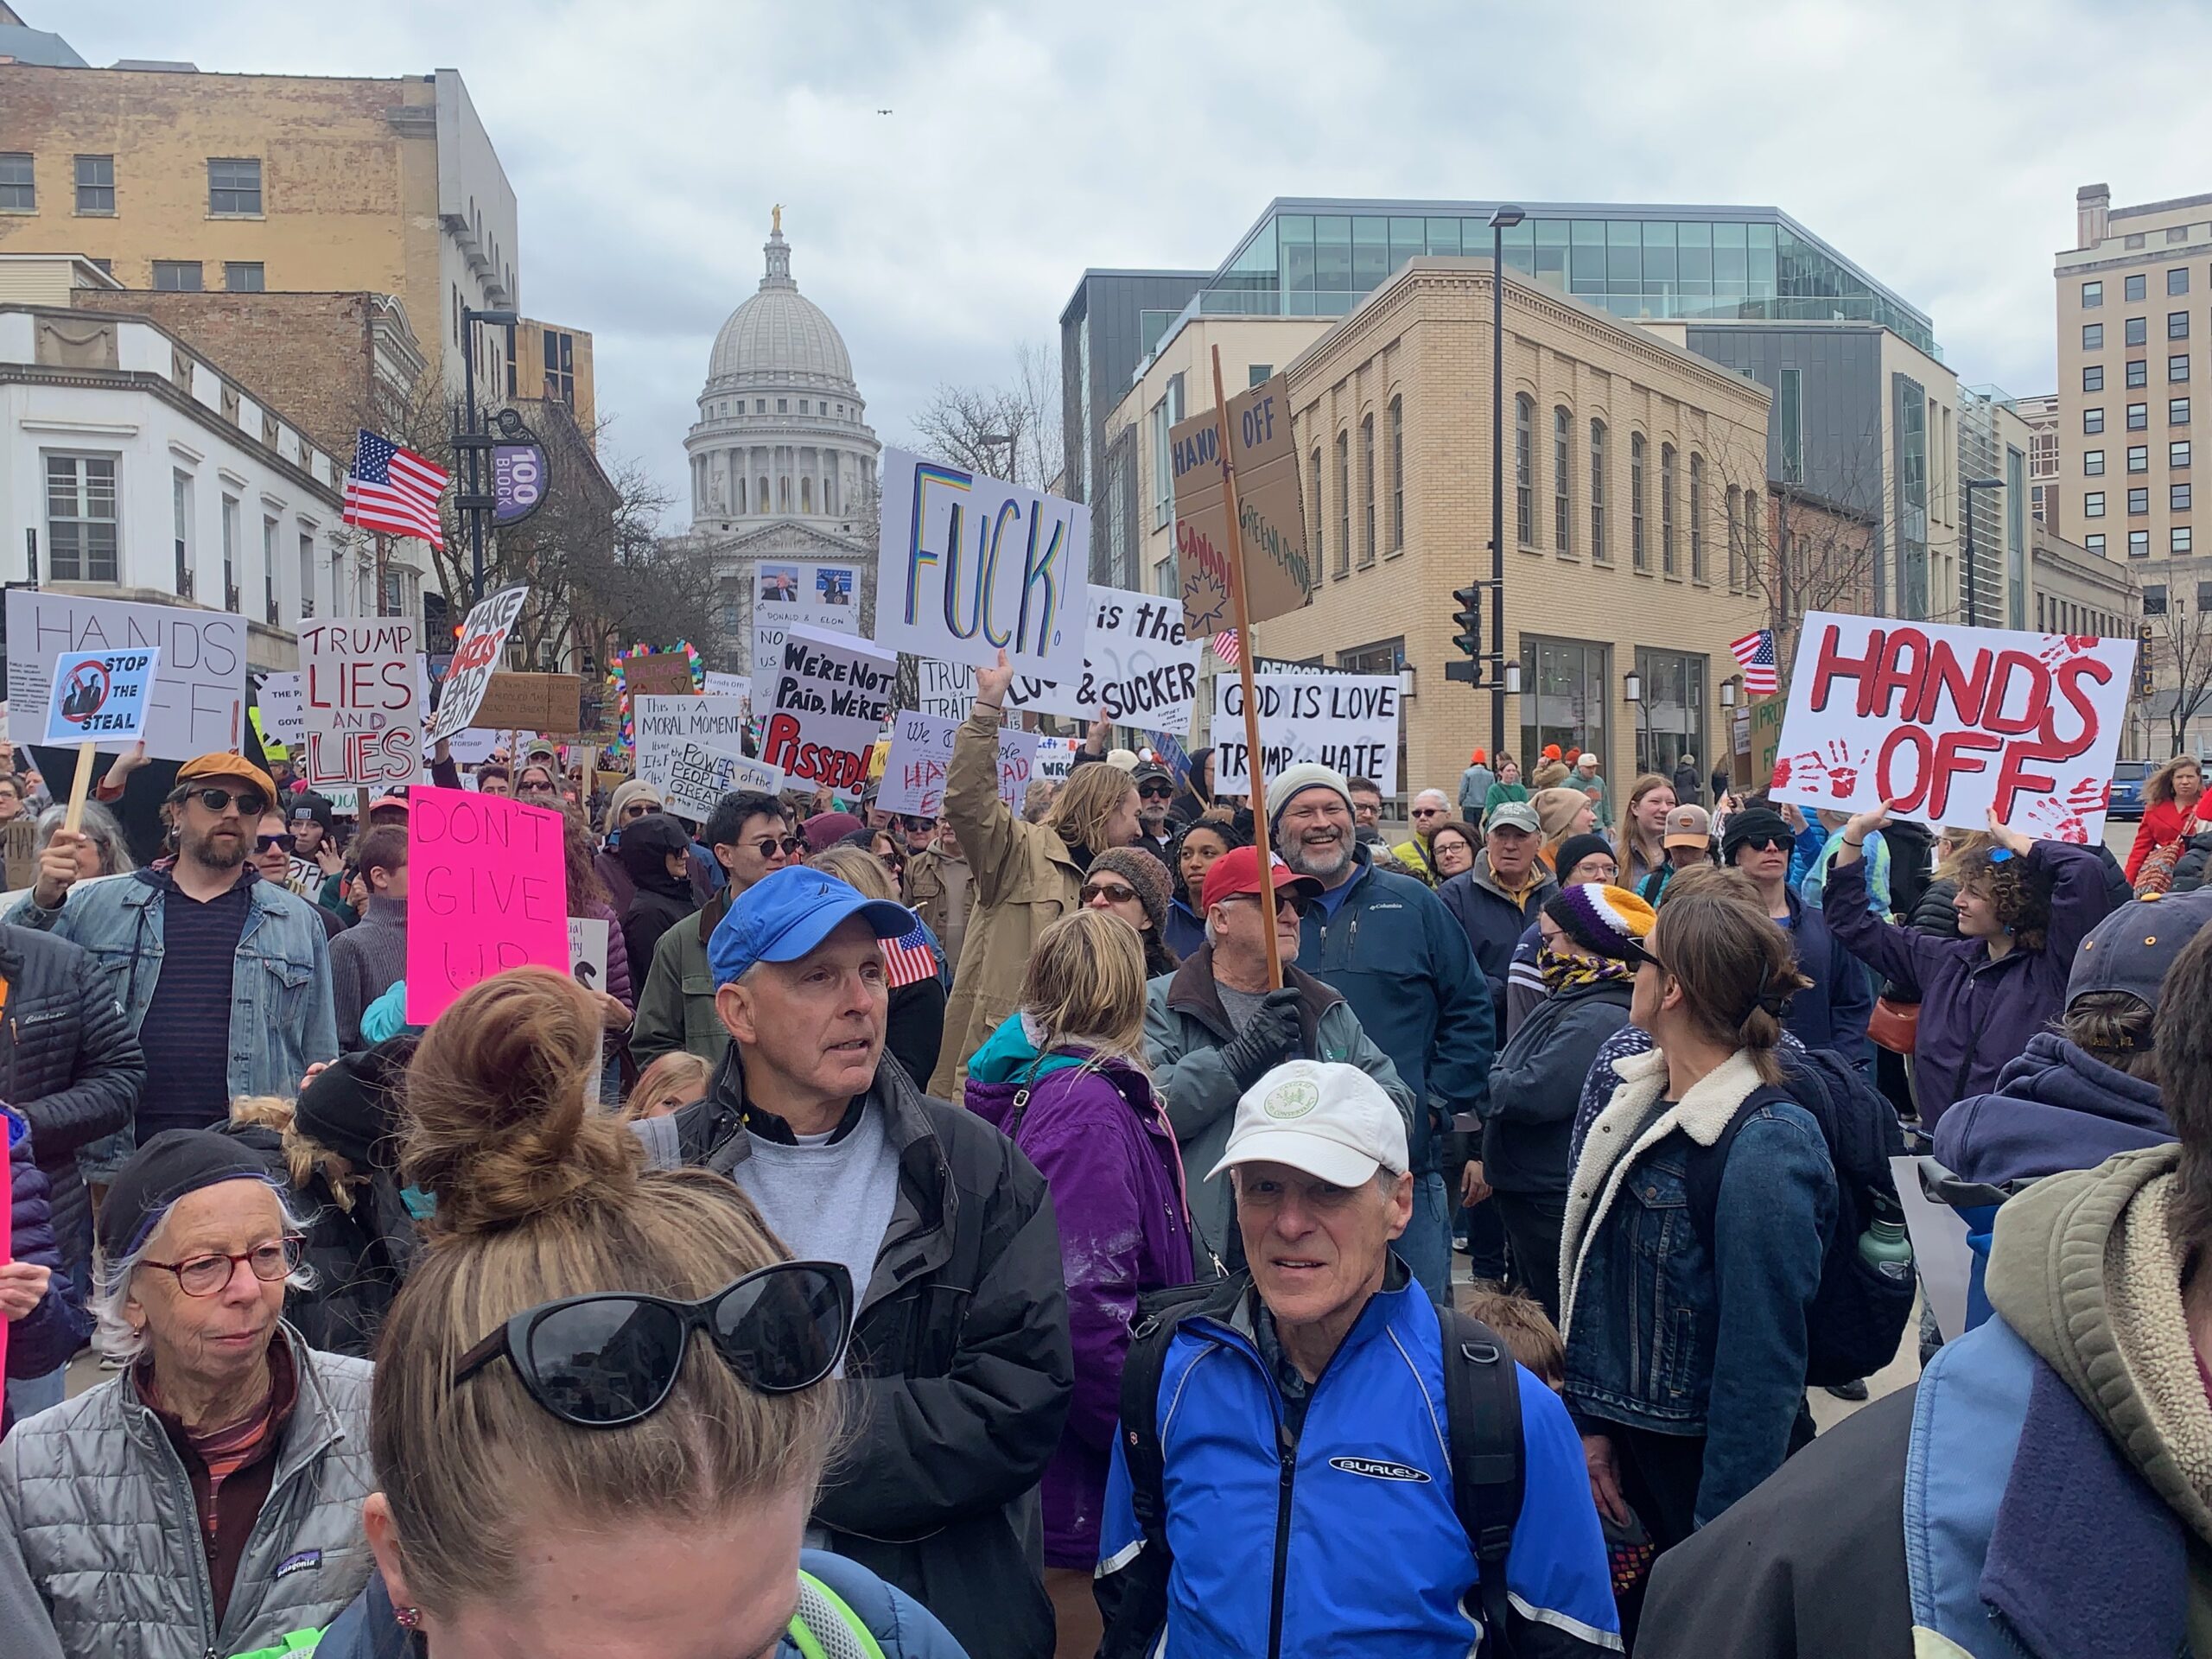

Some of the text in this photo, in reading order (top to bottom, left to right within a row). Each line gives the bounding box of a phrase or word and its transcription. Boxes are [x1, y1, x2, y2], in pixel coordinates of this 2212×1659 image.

[1243, 396, 1274, 448] OFF
[496, 457, 512, 505] BLOCK
[512, 448, 538, 505] 100
[905, 462, 1074, 658] FUCK!
[1176, 519, 1233, 599] CANADA
[1238, 497, 1310, 595] GREENLAND
[461, 591, 523, 639] MAKE
[767, 612, 798, 621] DONALD
[820, 616, 844, 625] ELON
[1096, 602, 1185, 645] is the
[36, 606, 236, 676] HANDS
[302, 626, 412, 656] TRUMP
[445, 627, 505, 683] NAZIS
[104, 656, 149, 673] STOP
[309, 662, 412, 710] LIES
[627, 661, 683, 678] HEALTHCARE
[849, 660, 894, 694] NOT
[112, 684, 138, 697] THE
[442, 667, 486, 710] BAD
[645, 698, 668, 713] This
[695, 700, 709, 712] A
[652, 681, 667, 693] IS
[1102, 663, 1196, 720] SUCKER
[1291, 685, 1321, 719] IS
[1332, 686, 1397, 719] LOVE
[1811, 624, 2113, 759] HANDS
[81, 713, 136, 731] STEAL
[333, 710, 387, 731] AND
[642, 715, 741, 735] MORAL MOMENT
[1010, 721, 1020, 730] 15
[307, 726, 416, 785] LIES
[671, 747, 683, 759] the
[683, 743, 735, 779] POWER
[740, 767, 755, 783] of
[755, 773, 772, 788] the
[671, 760, 730, 791] PEOPLE
[1320, 744, 1386, 778] HATE
[1876, 724, 2069, 825] OFF
[321, 792, 359, 809] DUCA
[416, 798, 550, 853] DON'T
[424, 866, 553, 924] GIVE
[444, 942, 529, 992] UP
[1340, 1460, 1419, 1478] BURLEY
[277, 1559, 315, 1578] patagonia
